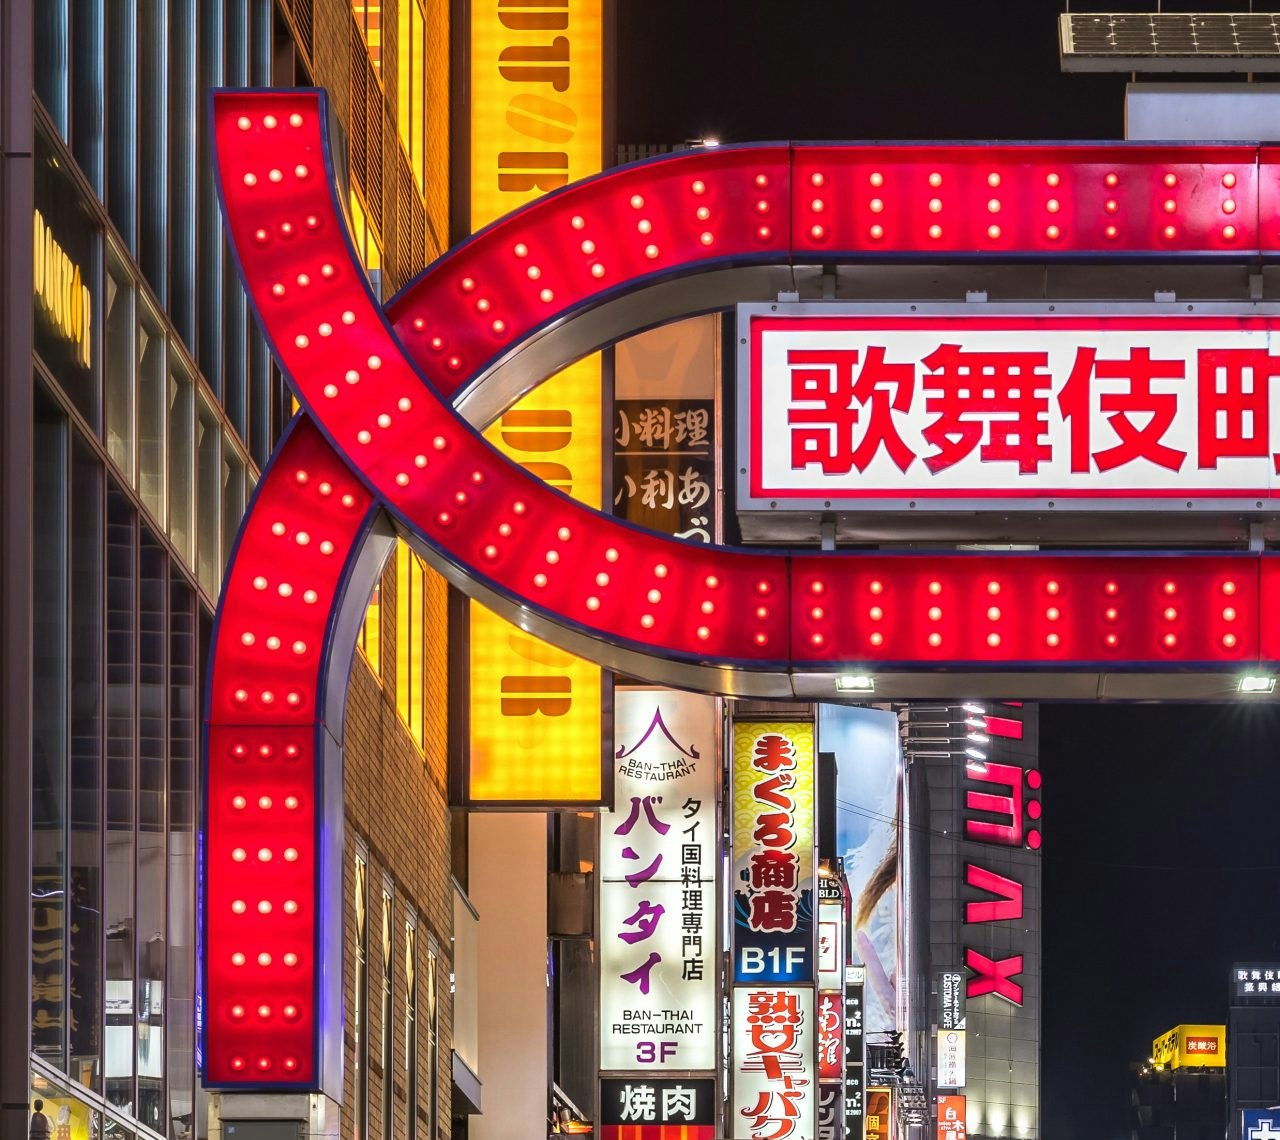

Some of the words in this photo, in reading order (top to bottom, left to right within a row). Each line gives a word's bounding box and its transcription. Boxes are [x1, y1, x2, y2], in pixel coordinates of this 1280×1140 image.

[618, 764, 698, 781] RESTAURANT
[628, 758, 687, 771] BAN-THAI
[751, 735, 798, 932] まぐろ商店
[614, 796, 671, 995] バンタイ
[681, 797, 703, 981] タイ国料理専門店
[741, 948, 806, 974] B1F
[622, 1010, 694, 1021] BAN-THAI
[612, 1022, 704, 1035] RESTAURANT
[636, 1041, 678, 1064] 3F
[620, 1085, 697, 1122] 焼肉
